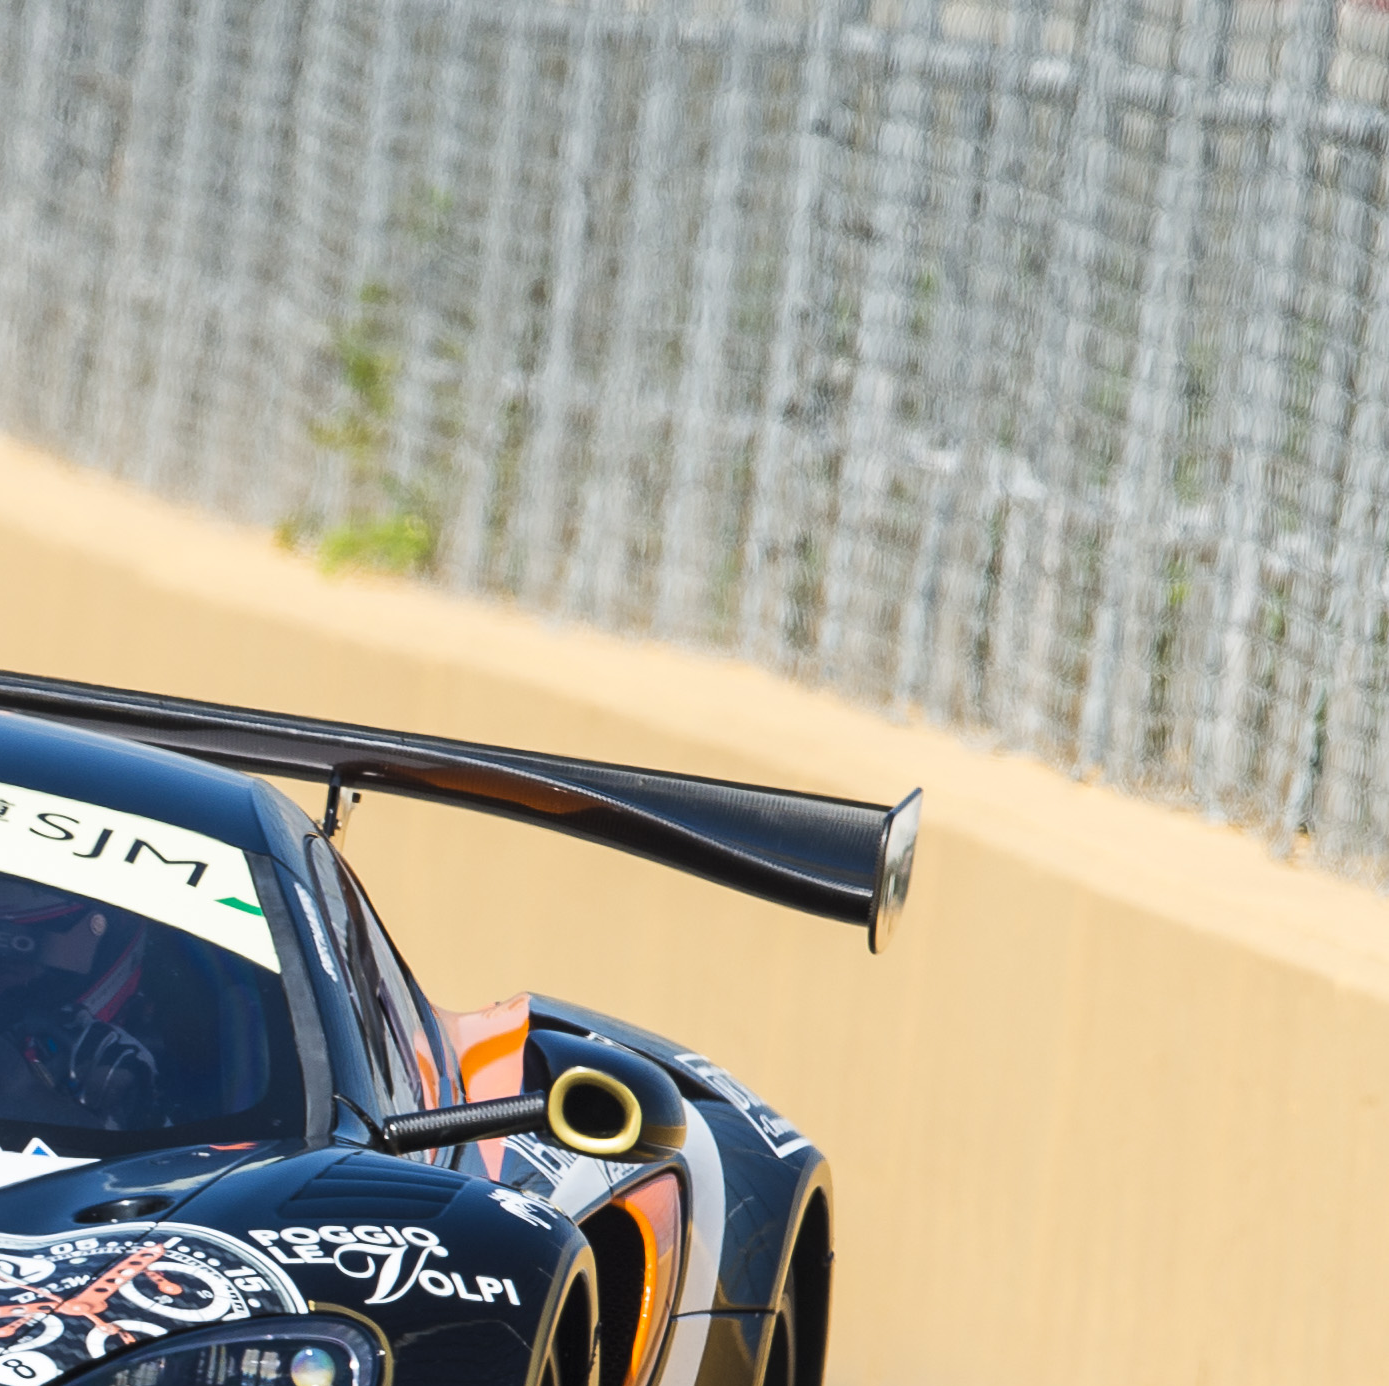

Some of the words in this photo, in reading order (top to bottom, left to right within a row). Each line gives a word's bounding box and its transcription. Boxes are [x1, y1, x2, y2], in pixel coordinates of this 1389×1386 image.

[28, 812, 209, 887] SJM
[248, 1225, 441, 1247] POGGIO
[266, 1245, 336, 1265] LE
[223, 1265, 272, 1292] 15
